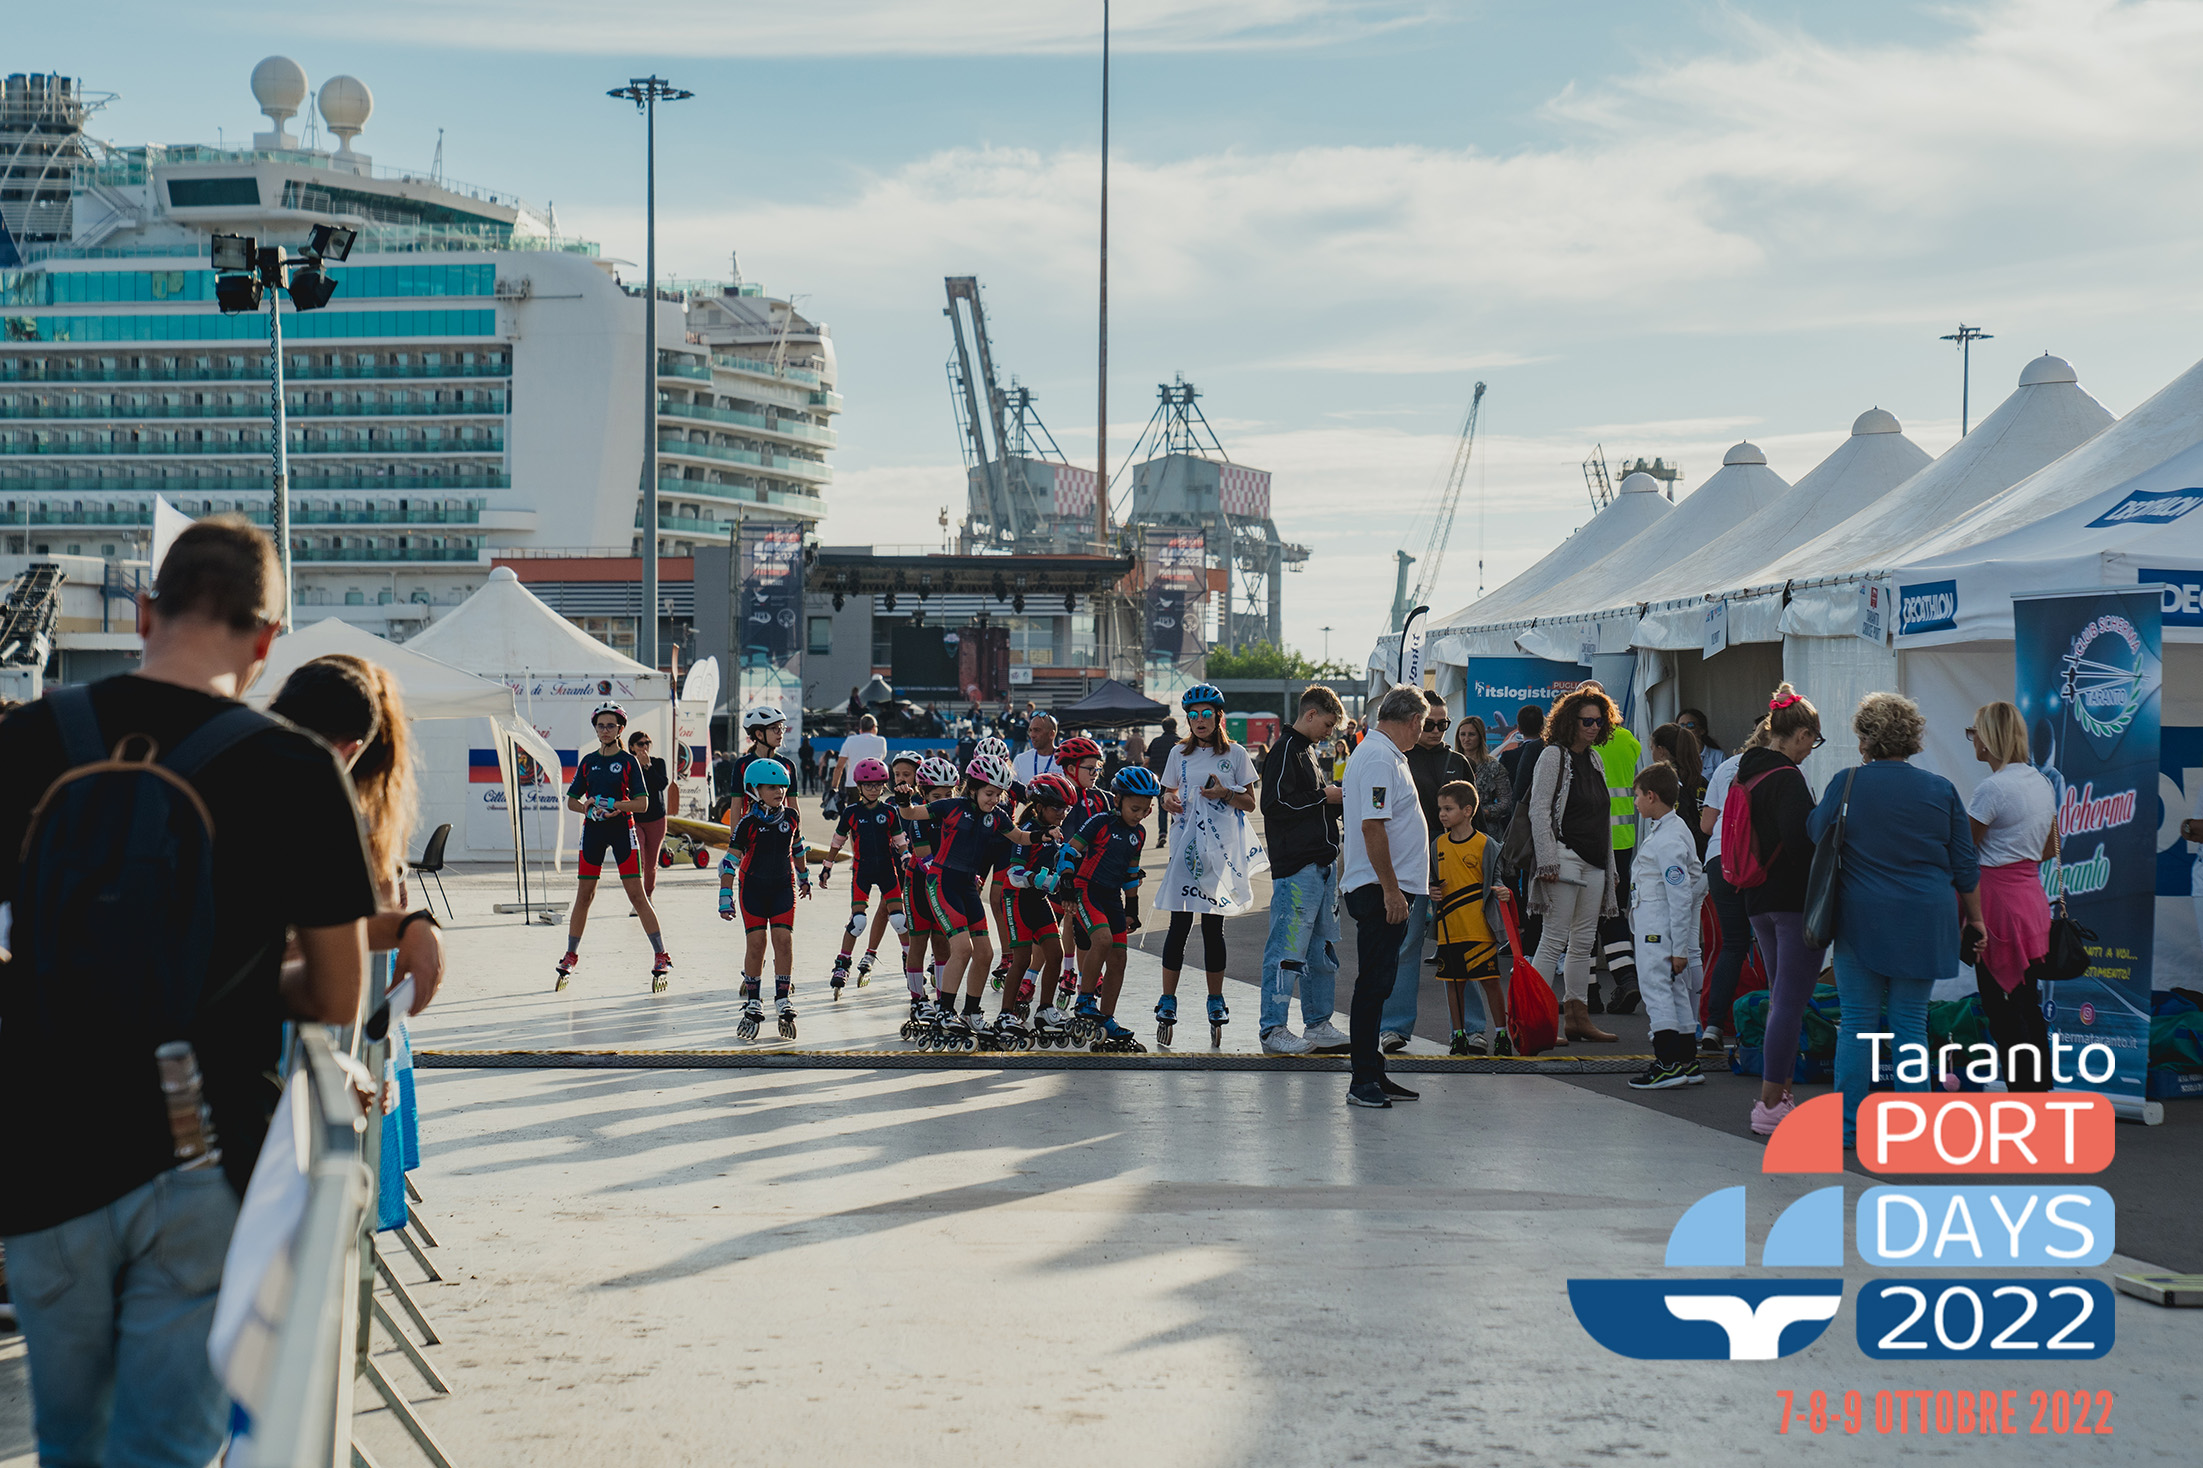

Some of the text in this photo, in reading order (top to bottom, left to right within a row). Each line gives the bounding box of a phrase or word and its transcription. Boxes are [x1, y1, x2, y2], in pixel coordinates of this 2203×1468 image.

[1903, 593, 1953, 623] DECATHLON
[2161, 584, 2203, 613] DE
[2075, 615, 2140, 656] CLUB SCHERMA
[550, 682, 594, 695] Taranto
[1485, 685, 1572, 700] itslogistic
[2086, 688, 2126, 706] TARANTO
[2059, 783, 2136, 837] Scherma
[2047, 1027, 2137, 1049] shermataranto.it
